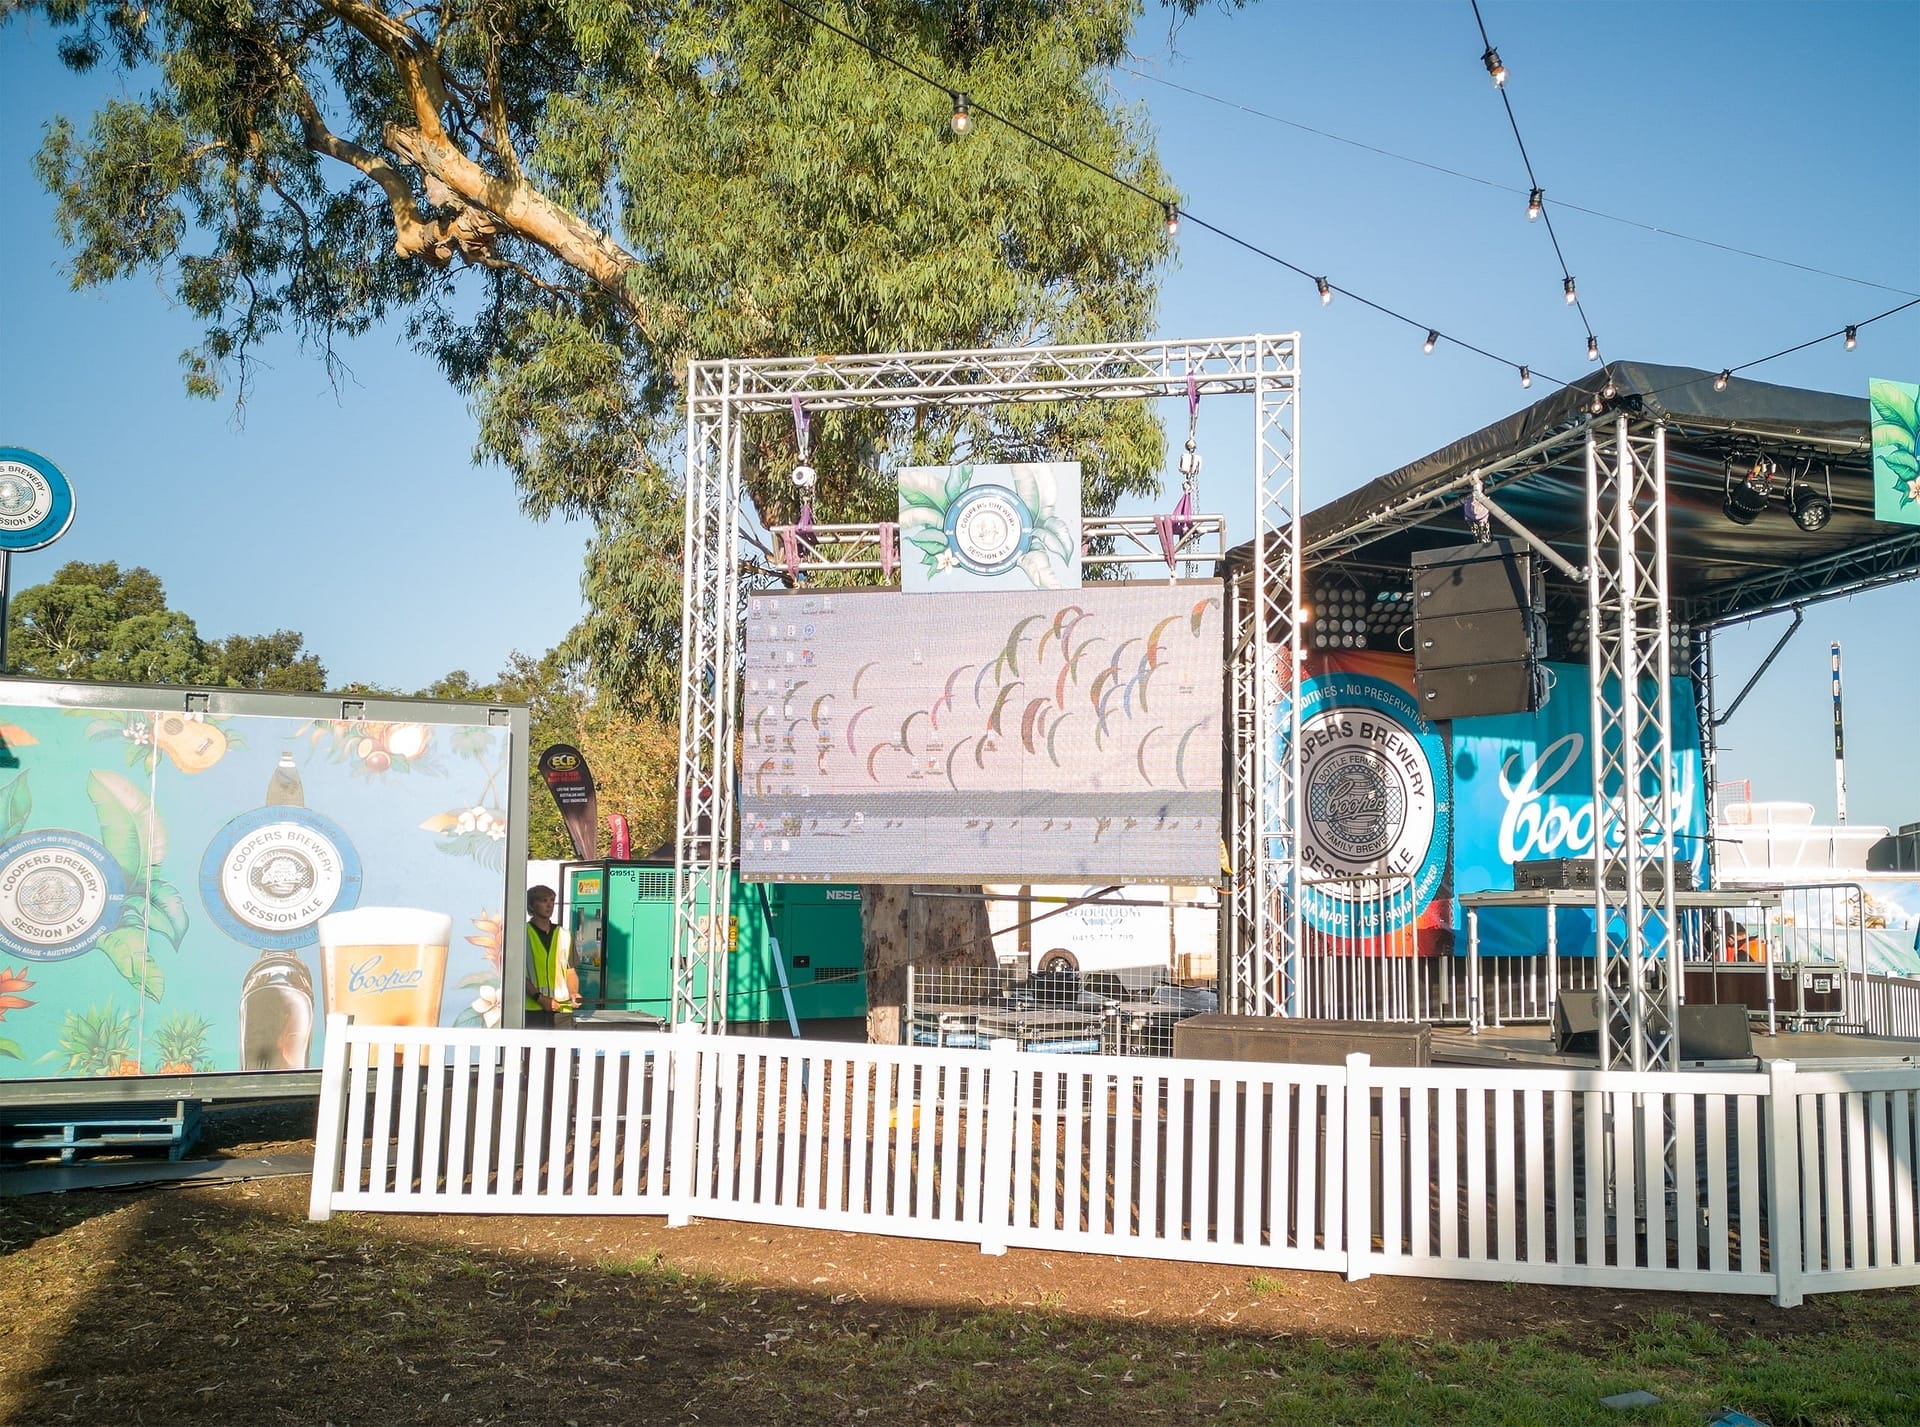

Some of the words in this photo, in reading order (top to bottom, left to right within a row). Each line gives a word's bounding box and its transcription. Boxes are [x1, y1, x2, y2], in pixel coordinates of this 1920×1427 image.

[9, 466, 45, 492] BREWERY
[0, 517, 26, 526] SSION
[28, 508, 42, 522] ALE
[1346, 684, 1361, 695] NO
[1364, 686, 1430, 736] PRESERVATIVES
[1318, 758, 1348, 782] BOTTLE
[1350, 756, 1394, 786] FERMENTED
[1360, 722, 1425, 798] BREWERY
[1326, 780, 1387, 822] Coopers
[232, 831, 282, 872] COOPERS
[288, 831, 334, 873] BREWERY
[1324, 832, 1352, 852] FAMILY
[1356, 832, 1390, 854] BREWED
[3, 855, 50, 892] COOPERS
[55, 855, 98, 893] BREWERY
[1301, 845, 1382, 889] SESSION
[1386, 848, 1414, 882] ALE
[242, 900, 297, 922] SESSION
[302, 897, 323, 917] ALE
[12, 917, 62, 938] SESSION
[66, 917, 87, 934] ALE
[46, 940, 86, 956] AUSTRALIAN
[86, 926, 106, 946] OWNED
[348, 955, 422, 994] Coopers
